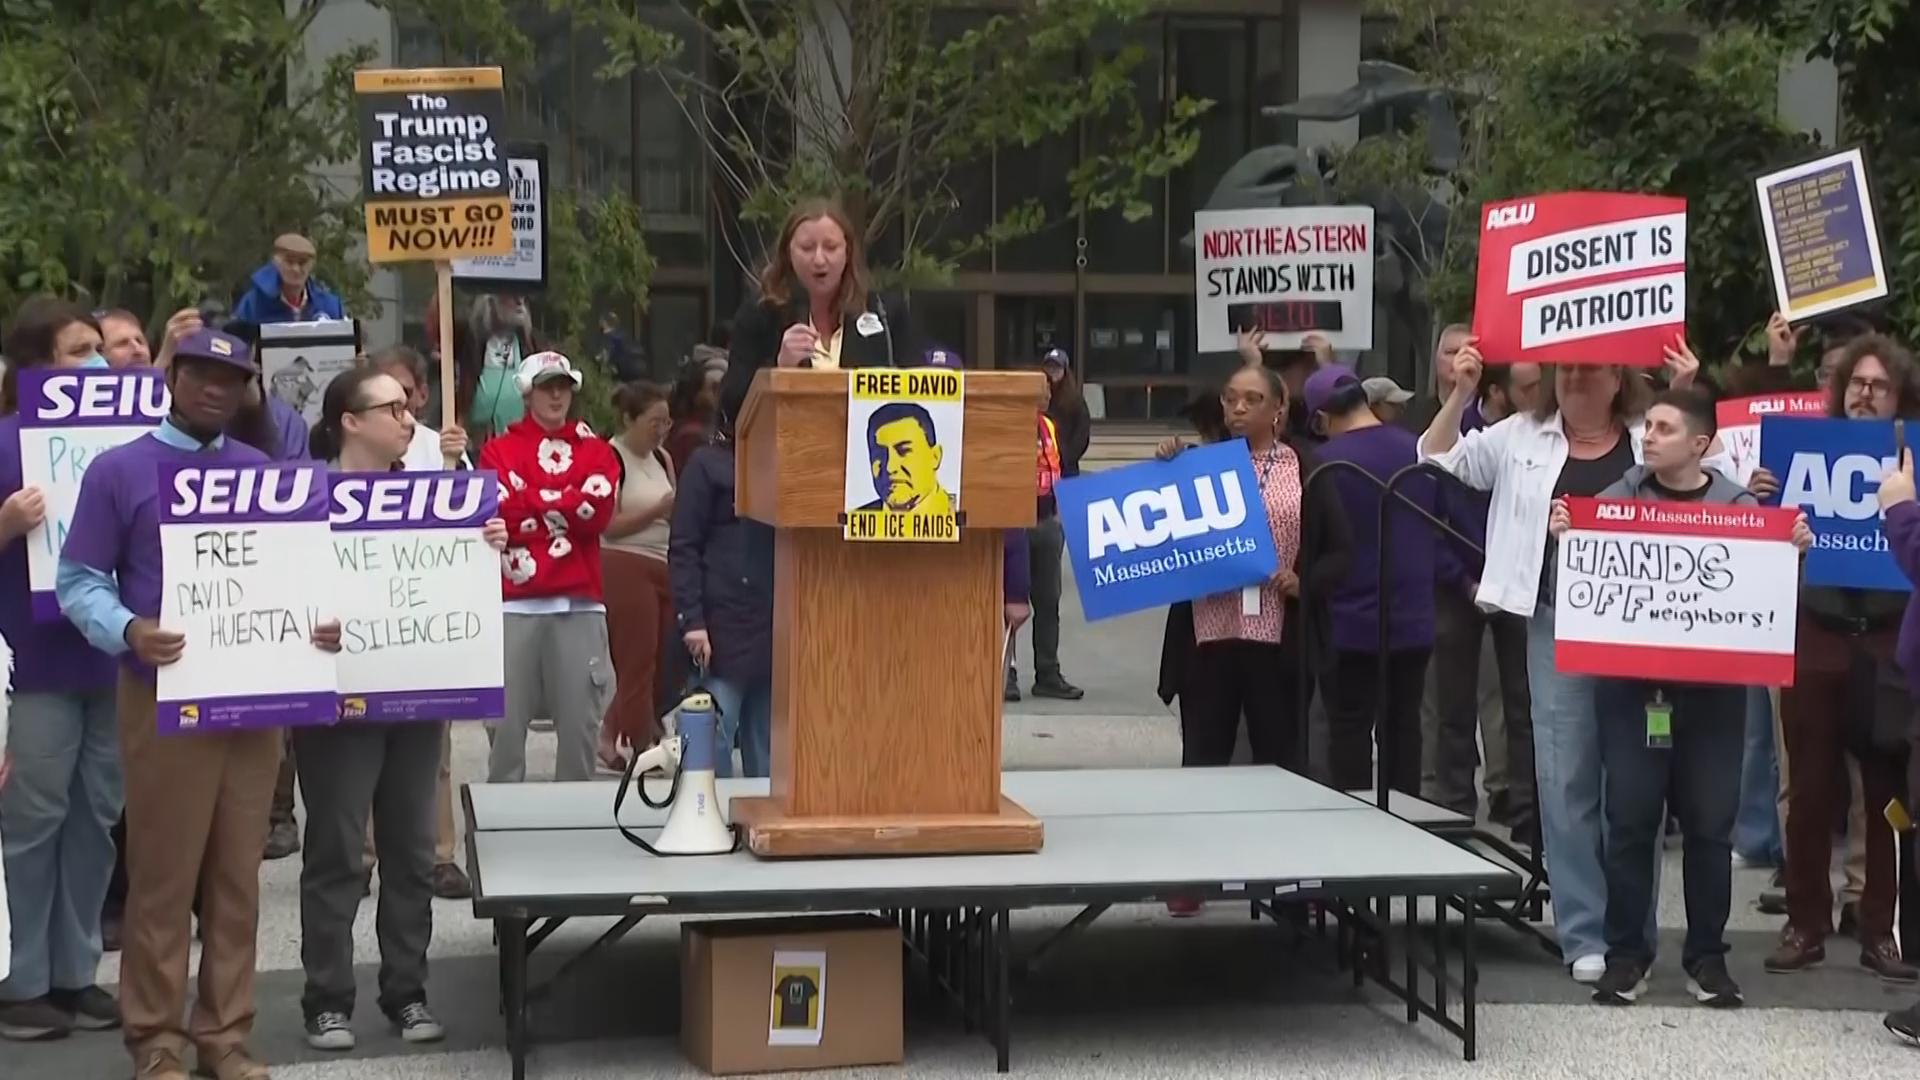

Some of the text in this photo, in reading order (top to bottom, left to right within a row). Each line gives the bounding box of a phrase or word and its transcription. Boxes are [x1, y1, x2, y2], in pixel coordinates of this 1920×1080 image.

[407, 94, 448, 111] The
[375, 112, 488, 139] Trump
[372, 137, 497, 166] Fascist
[373, 166, 501, 197] Regime
[375, 204, 503, 227] MUST GO
[1486, 202, 1536, 231] ACLU
[388, 226, 496, 250] NOW!!!
[1203, 223, 1366, 260] NORTHEASTERN
[1527, 225, 1673, 280] DISSENT IS
[1207, 263, 1354, 297] STANDS WITH
[1540, 283, 1674, 335] PATRIOTIC
[37, 375, 172, 419] SEIU
[855, 374, 958, 396] FREE DAVID
[1748, 398, 1786, 414] ACLU
[171, 467, 314, 517] SEIU
[329, 478, 485, 524] SEIU
[850, 513, 953, 537] END ICE RAIDS
[1087, 469, 1247, 560] ACLU
[1596, 503, 1765, 528] ACLU Massachusetts
[194, 530, 259, 570] FREE
[333, 537, 478, 572] WE WONT
[1093, 535, 1257, 587] Massachusetts
[1567, 538, 1734, 591] HANDS
[176, 577, 244, 617] DAVID
[388, 577, 428, 608] BE
[1568, 581, 1702, 622] OFF our
[345, 611, 481, 654] SILENCED
